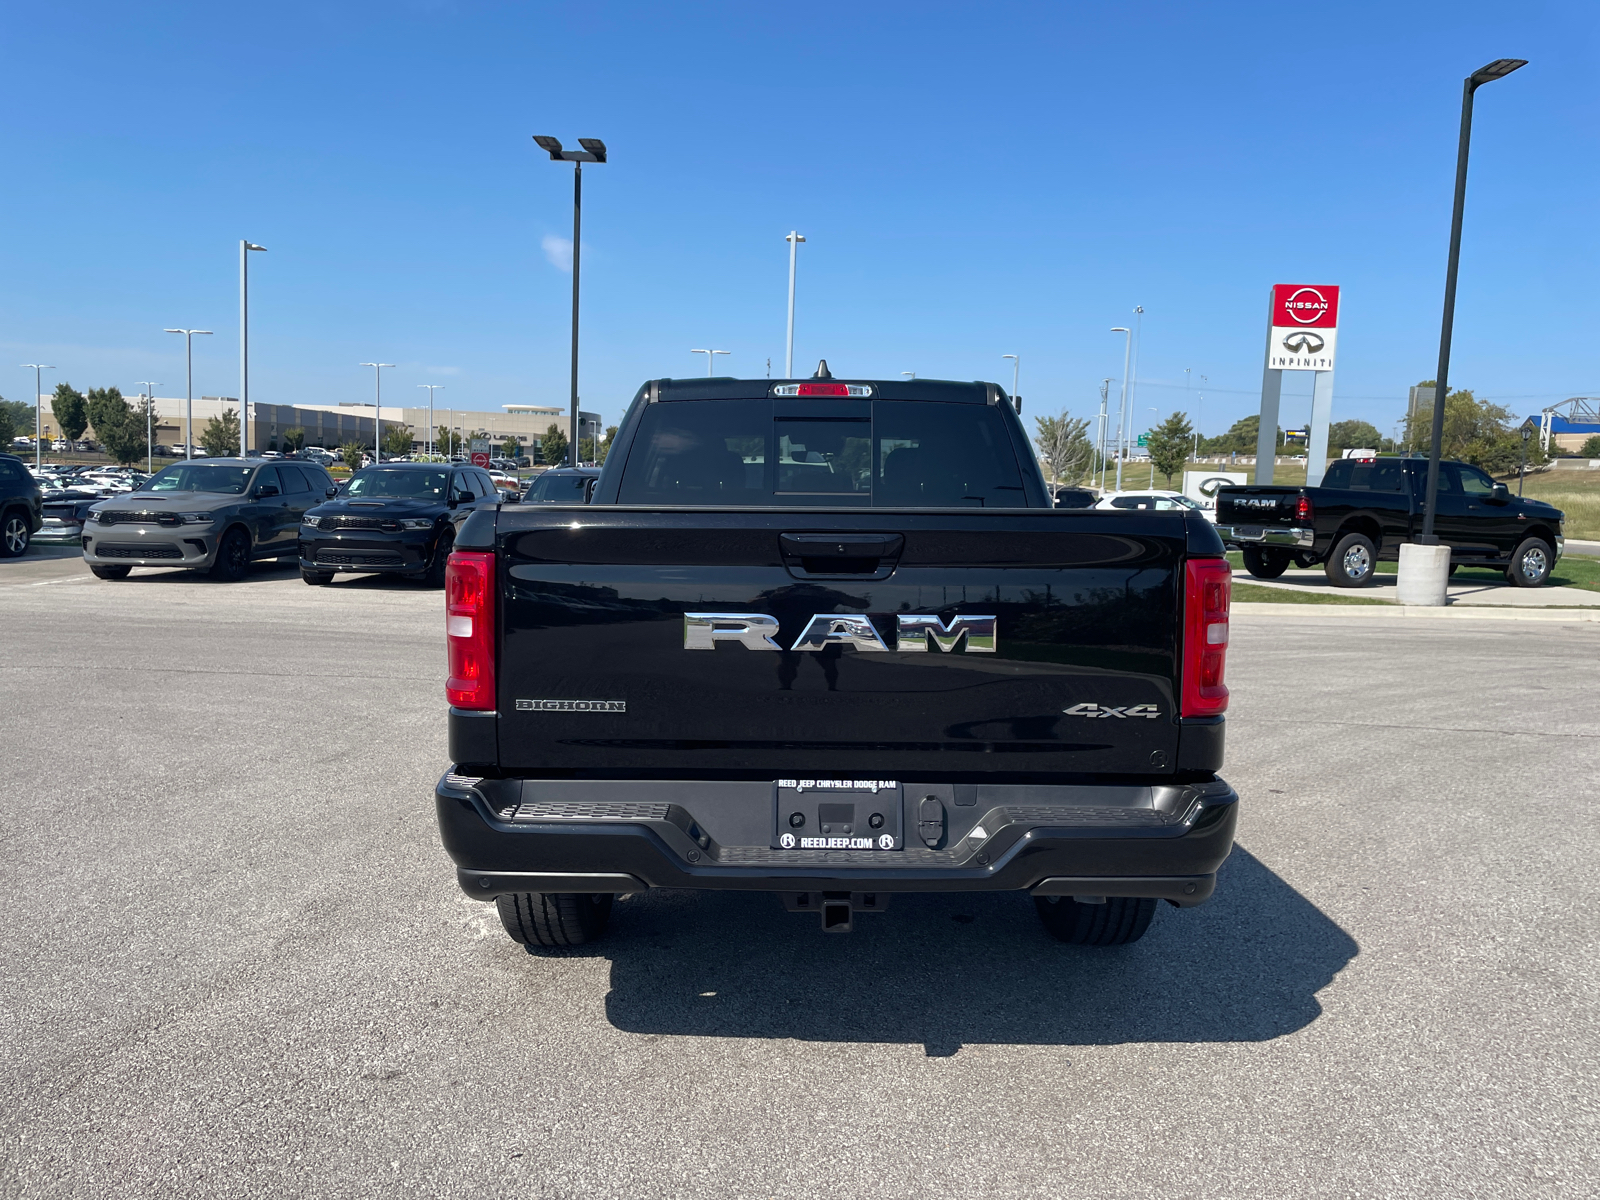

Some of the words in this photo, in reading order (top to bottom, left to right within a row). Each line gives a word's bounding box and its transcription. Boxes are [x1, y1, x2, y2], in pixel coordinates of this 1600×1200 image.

[1272, 357, 1332, 367] INFINITI
[1234, 499, 1276, 507] RAM
[683, 612, 997, 652] RAM
[516, 699, 626, 713] BIGHORN
[1062, 702, 1162, 719] 4x4
[778, 780, 796, 788] REED
[798, 780, 816, 788] JEEP
[816, 780, 852, 788] CHRYSLER
[854, 780, 878, 788] DODGE
[878, 780, 896, 788] RAM
[800, 838, 872, 848] REEDJEEP.COM
